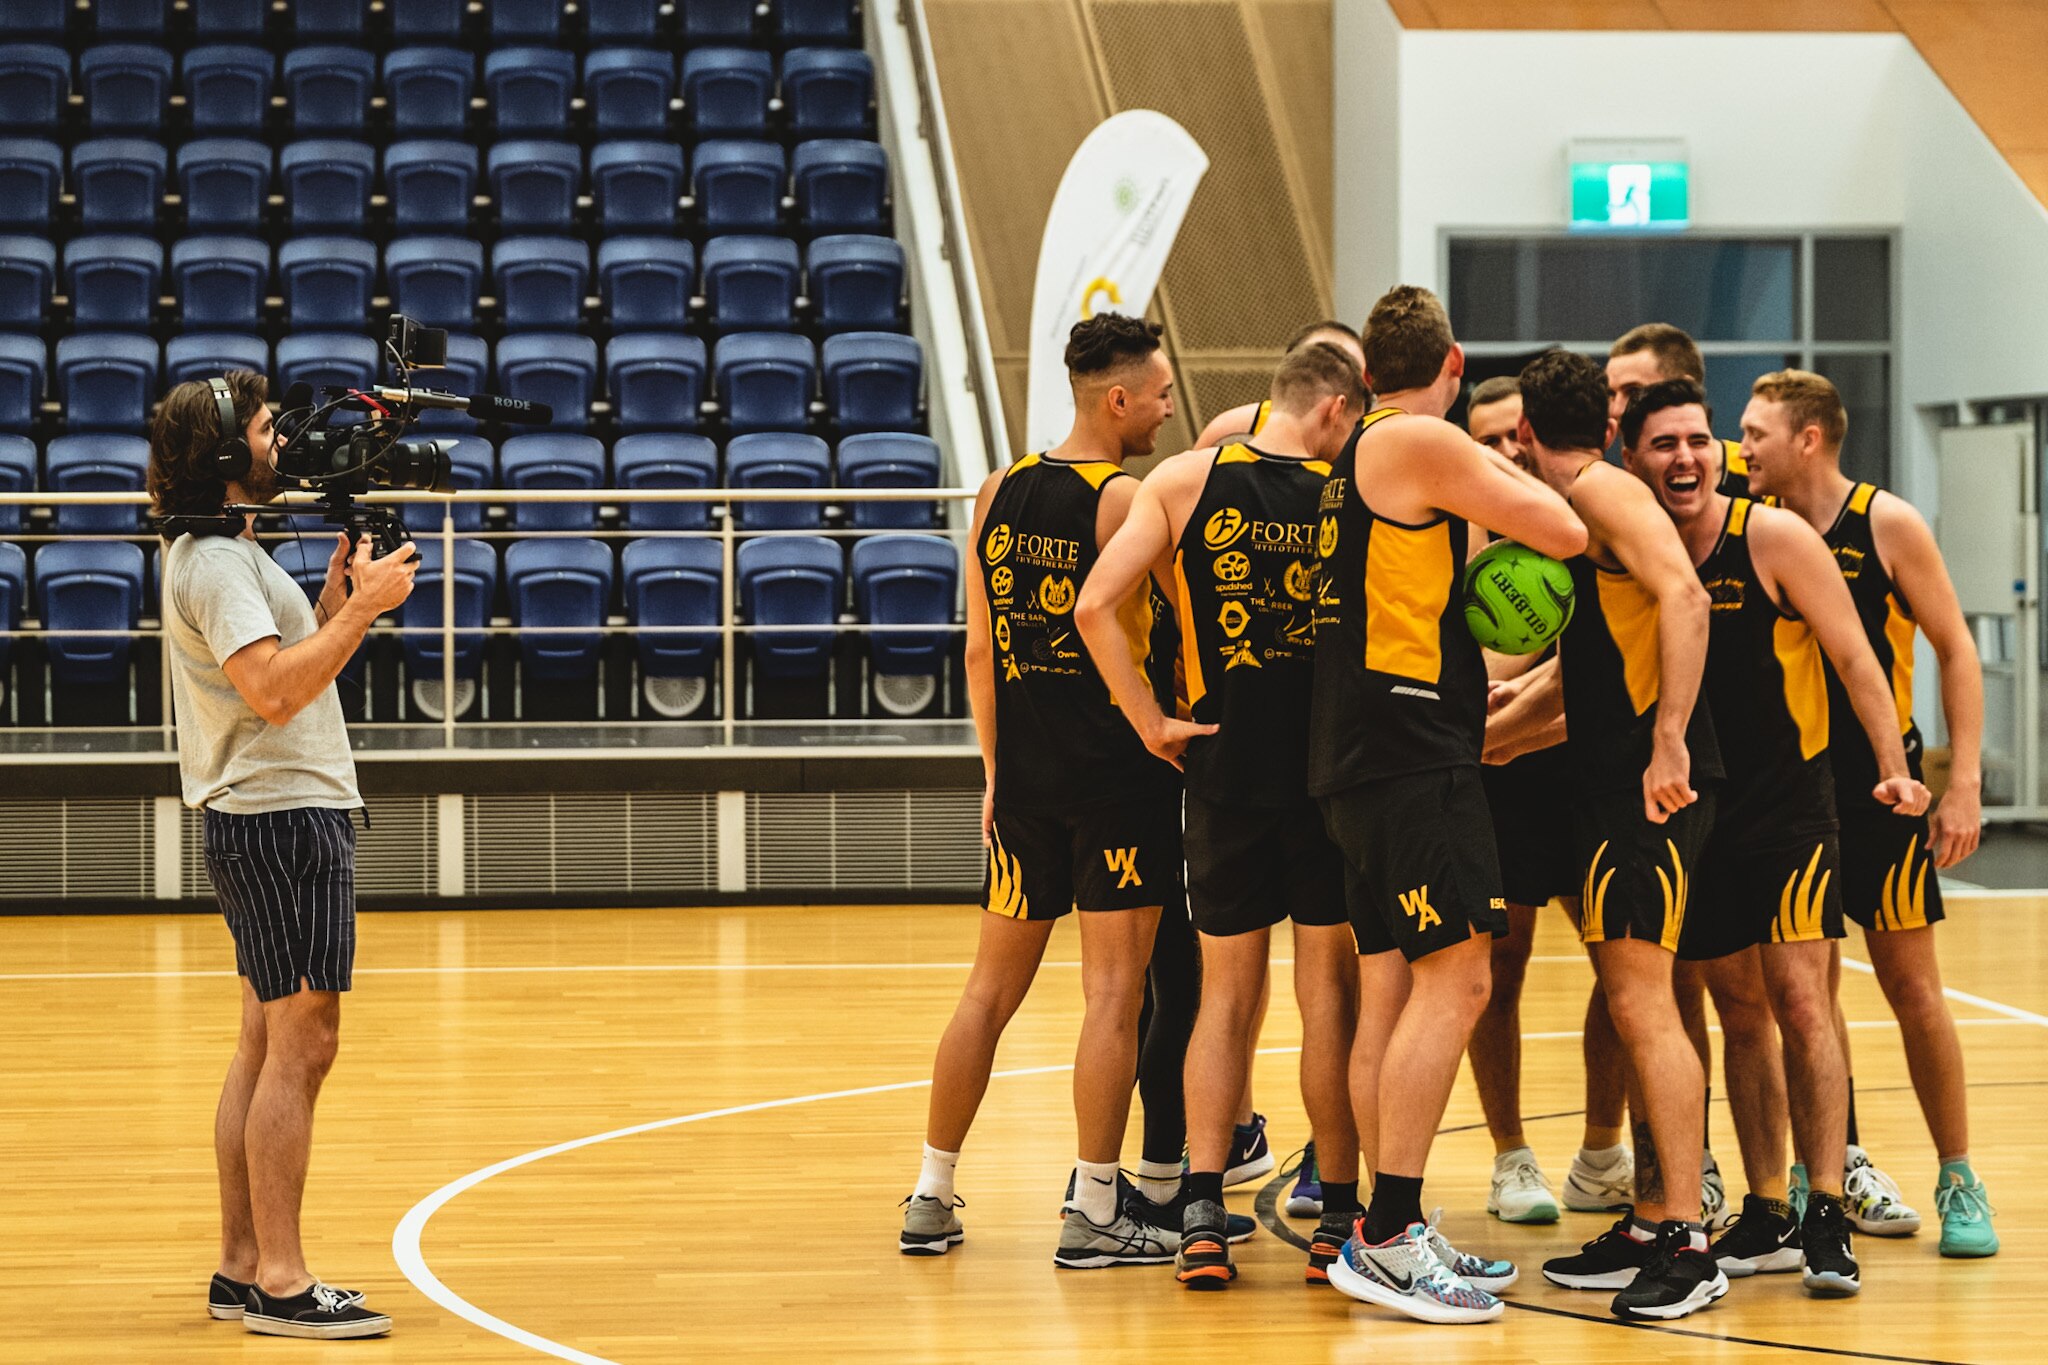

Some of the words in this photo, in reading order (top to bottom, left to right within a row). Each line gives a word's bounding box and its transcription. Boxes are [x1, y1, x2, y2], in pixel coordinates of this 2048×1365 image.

[494, 396, 531, 411] RØDE
[1251, 520, 1317, 545] FORT
[1016, 533, 1080, 562] FORTE
[1252, 543, 1313, 554] HYSIOTHER
[1250, 598, 1266, 606] THE
[1490, 571, 1548, 635] GILBERT
[1010, 612, 1026, 620] THE
[1103, 846, 1143, 889] WA
[1398, 884, 1442, 932] WA
